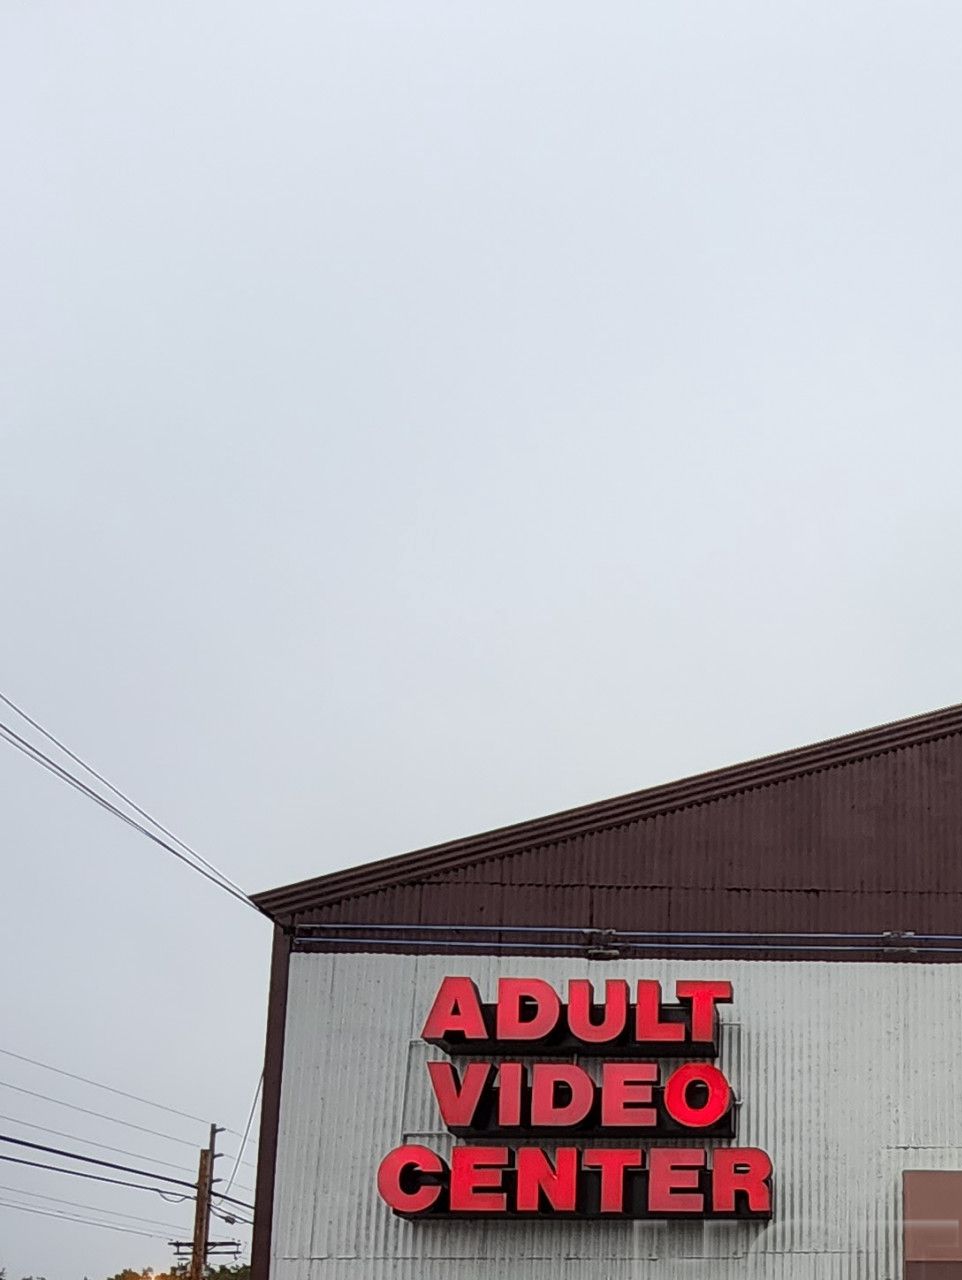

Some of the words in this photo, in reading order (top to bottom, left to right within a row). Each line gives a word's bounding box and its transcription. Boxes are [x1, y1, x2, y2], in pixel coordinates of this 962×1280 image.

[421, 976, 733, 1044] ADULT
[427, 1061, 731, 1128] VIDEO
[377, 1144, 773, 1213] CENTER
